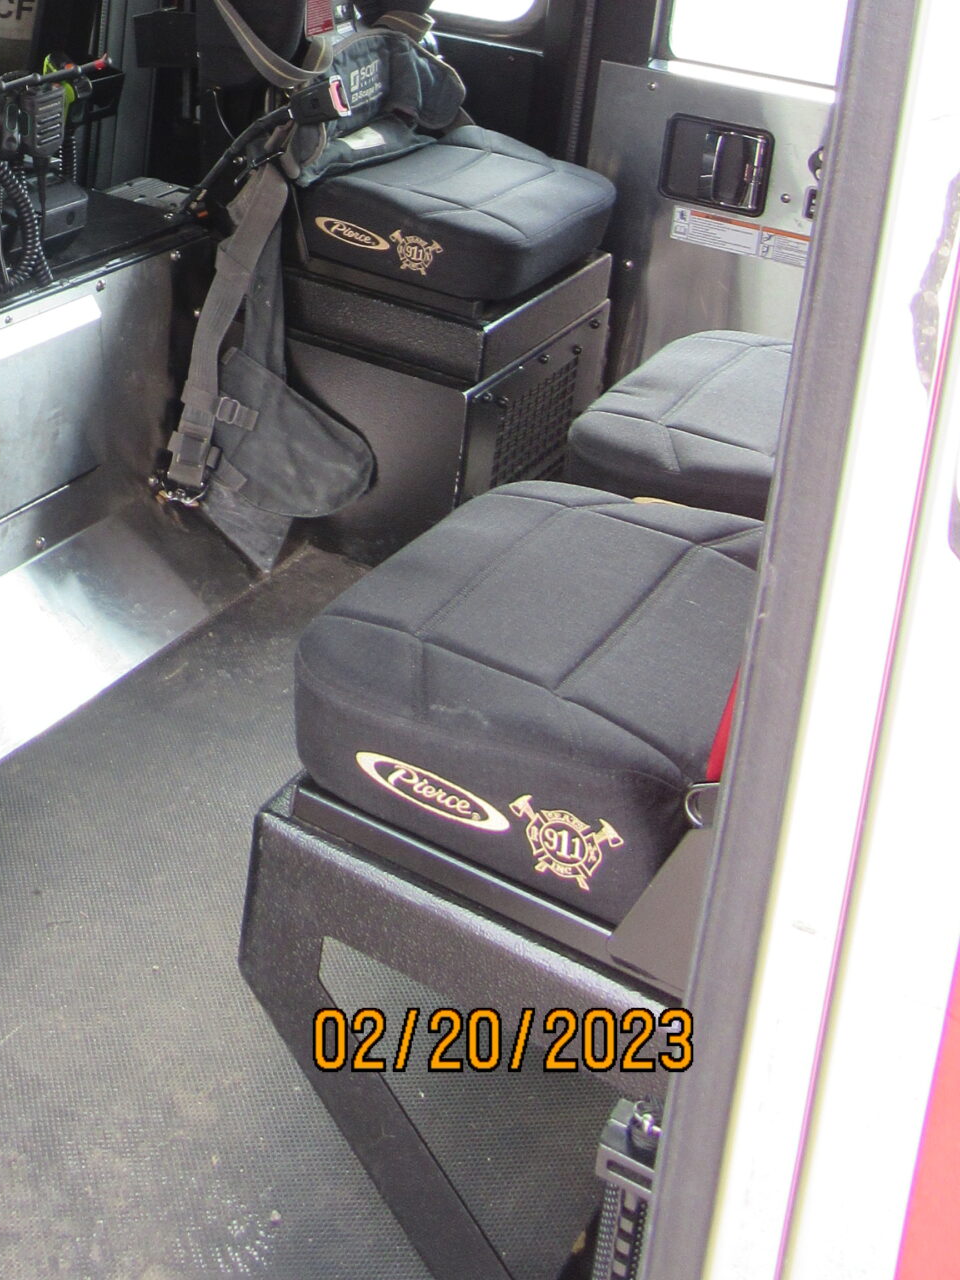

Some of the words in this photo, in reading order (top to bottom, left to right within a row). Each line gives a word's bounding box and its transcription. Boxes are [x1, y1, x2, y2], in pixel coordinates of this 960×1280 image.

[330, 221, 372, 244] Pierce
[405, 244, 424, 261] 911
[387, 764, 473, 814] Pierce
[543, 829, 583, 860] 911
